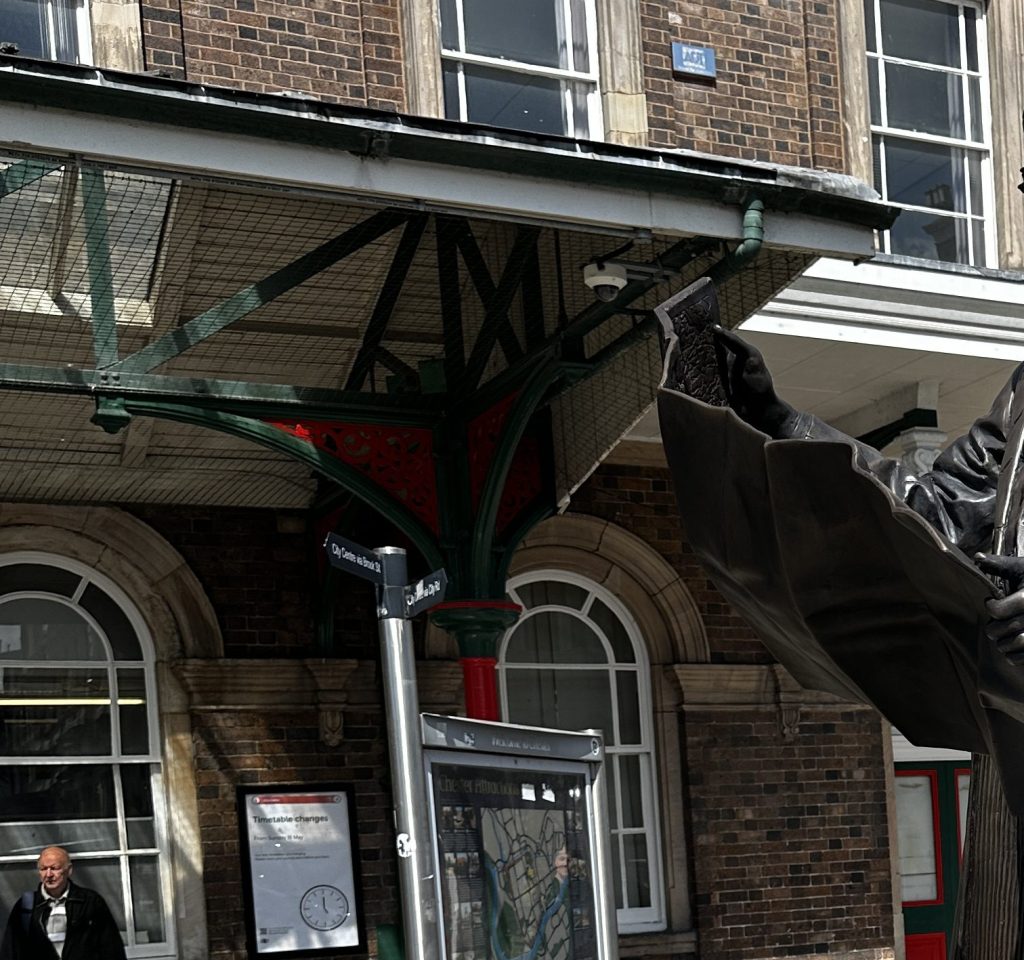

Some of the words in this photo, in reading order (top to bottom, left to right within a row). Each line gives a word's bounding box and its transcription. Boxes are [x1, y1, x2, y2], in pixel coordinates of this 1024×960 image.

[332, 543, 341, 559] City
[341, 547, 356, 562] Centre
[252, 815, 293, 823] Timetable
[295, 815, 328, 824] changes
